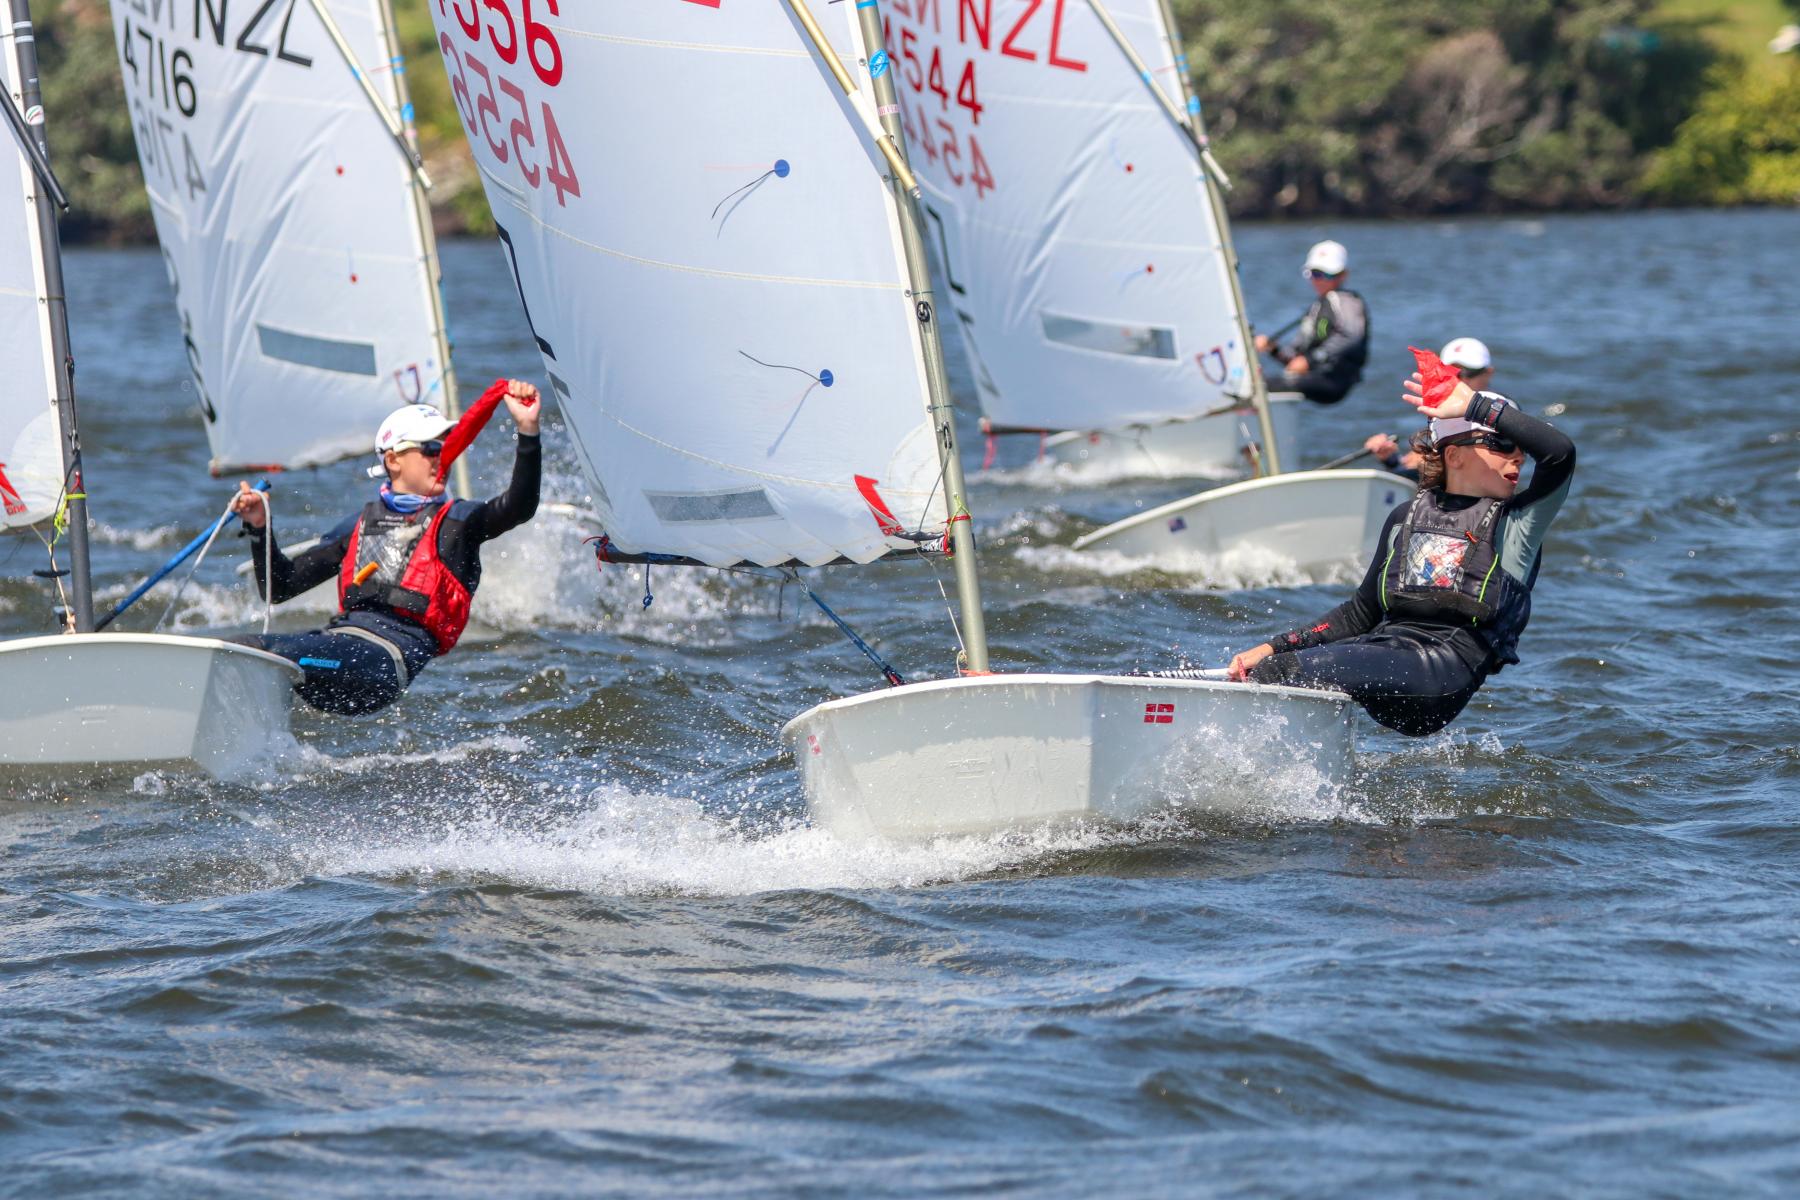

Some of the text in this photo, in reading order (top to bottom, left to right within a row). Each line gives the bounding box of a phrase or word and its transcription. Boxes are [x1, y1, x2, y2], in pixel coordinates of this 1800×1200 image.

[124, 16, 197, 118] 4716
[193, 0, 312, 67] NZL
[884, 13, 984, 126] 4544
[959, 0, 1088, 72] NZL
[1481, 501, 1502, 527] LTIC
